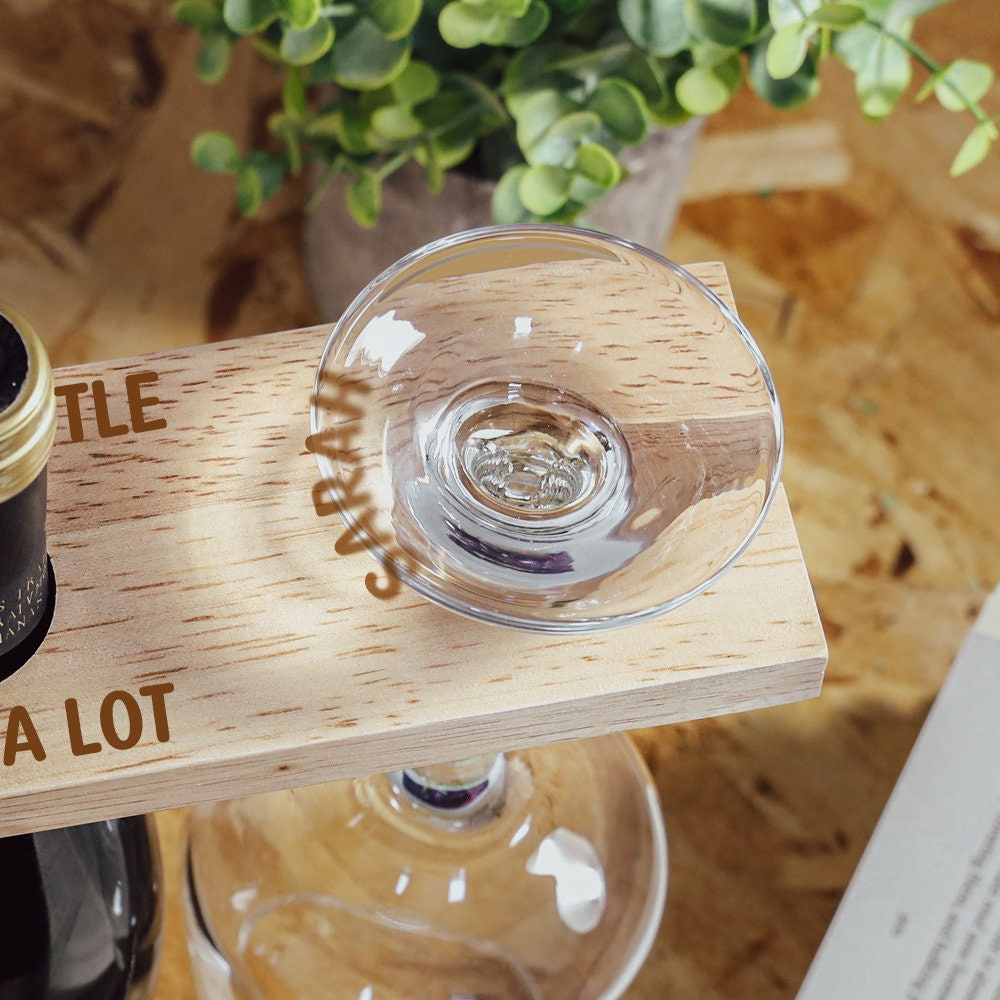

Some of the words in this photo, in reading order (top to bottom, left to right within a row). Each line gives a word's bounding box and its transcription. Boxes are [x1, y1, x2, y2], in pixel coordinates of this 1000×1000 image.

[53, 371, 167, 442] TLE
[305, 369, 418, 599] SARAH
[3, 705, 46, 767] A
[64, 683, 175, 757] LOT
